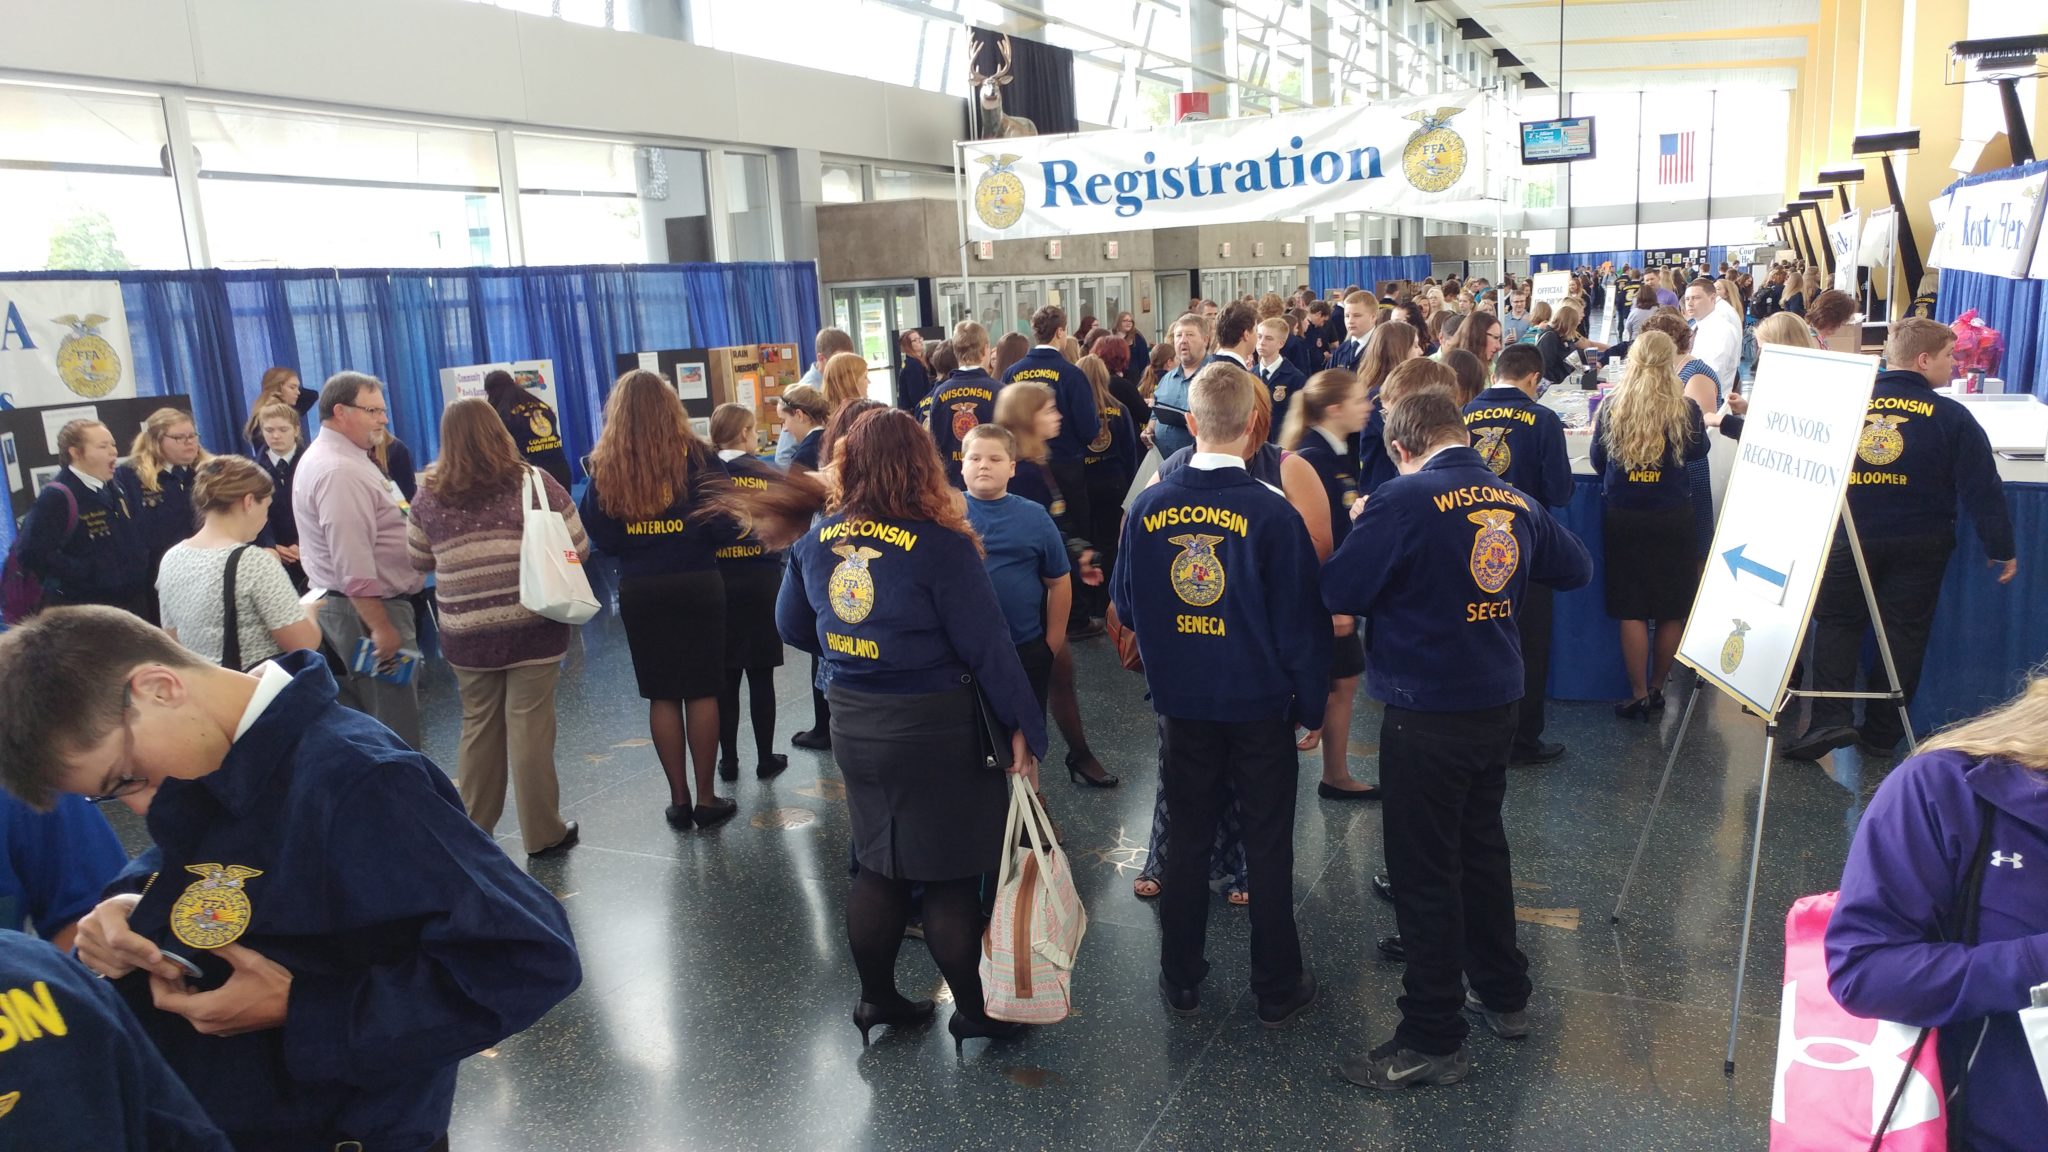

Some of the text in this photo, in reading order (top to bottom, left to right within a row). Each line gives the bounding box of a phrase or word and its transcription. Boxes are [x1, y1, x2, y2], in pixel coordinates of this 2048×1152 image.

[1423, 144, 1447, 154] FFA
[1038, 135, 1386, 218] Registration
[990, 186, 1008, 195] FFA
[76, 350, 101, 361] FFA
[1013, 368, 1060, 383] WISCONSIN
[940, 386, 993, 403] WISCONSIN
[1867, 397, 1934, 417] SCONSIN
[1765, 410, 1833, 444] SPONSORS
[1742, 442, 1840, 488] REGISTRATION
[1628, 470, 1662, 484] AMERY
[1848, 471, 1908, 485] BLOOMER
[1433, 486, 1531, 513] WISCONSIN
[626, 518, 684, 535] WATERLOO
[1143, 505, 1249, 538] WISCONSIN
[819, 520, 918, 551] WISCONSIN
[843, 579, 859, 589] FFA
[1176, 614, 1226, 637] SENECA
[826, 632, 880, 660] HIGHLAND
